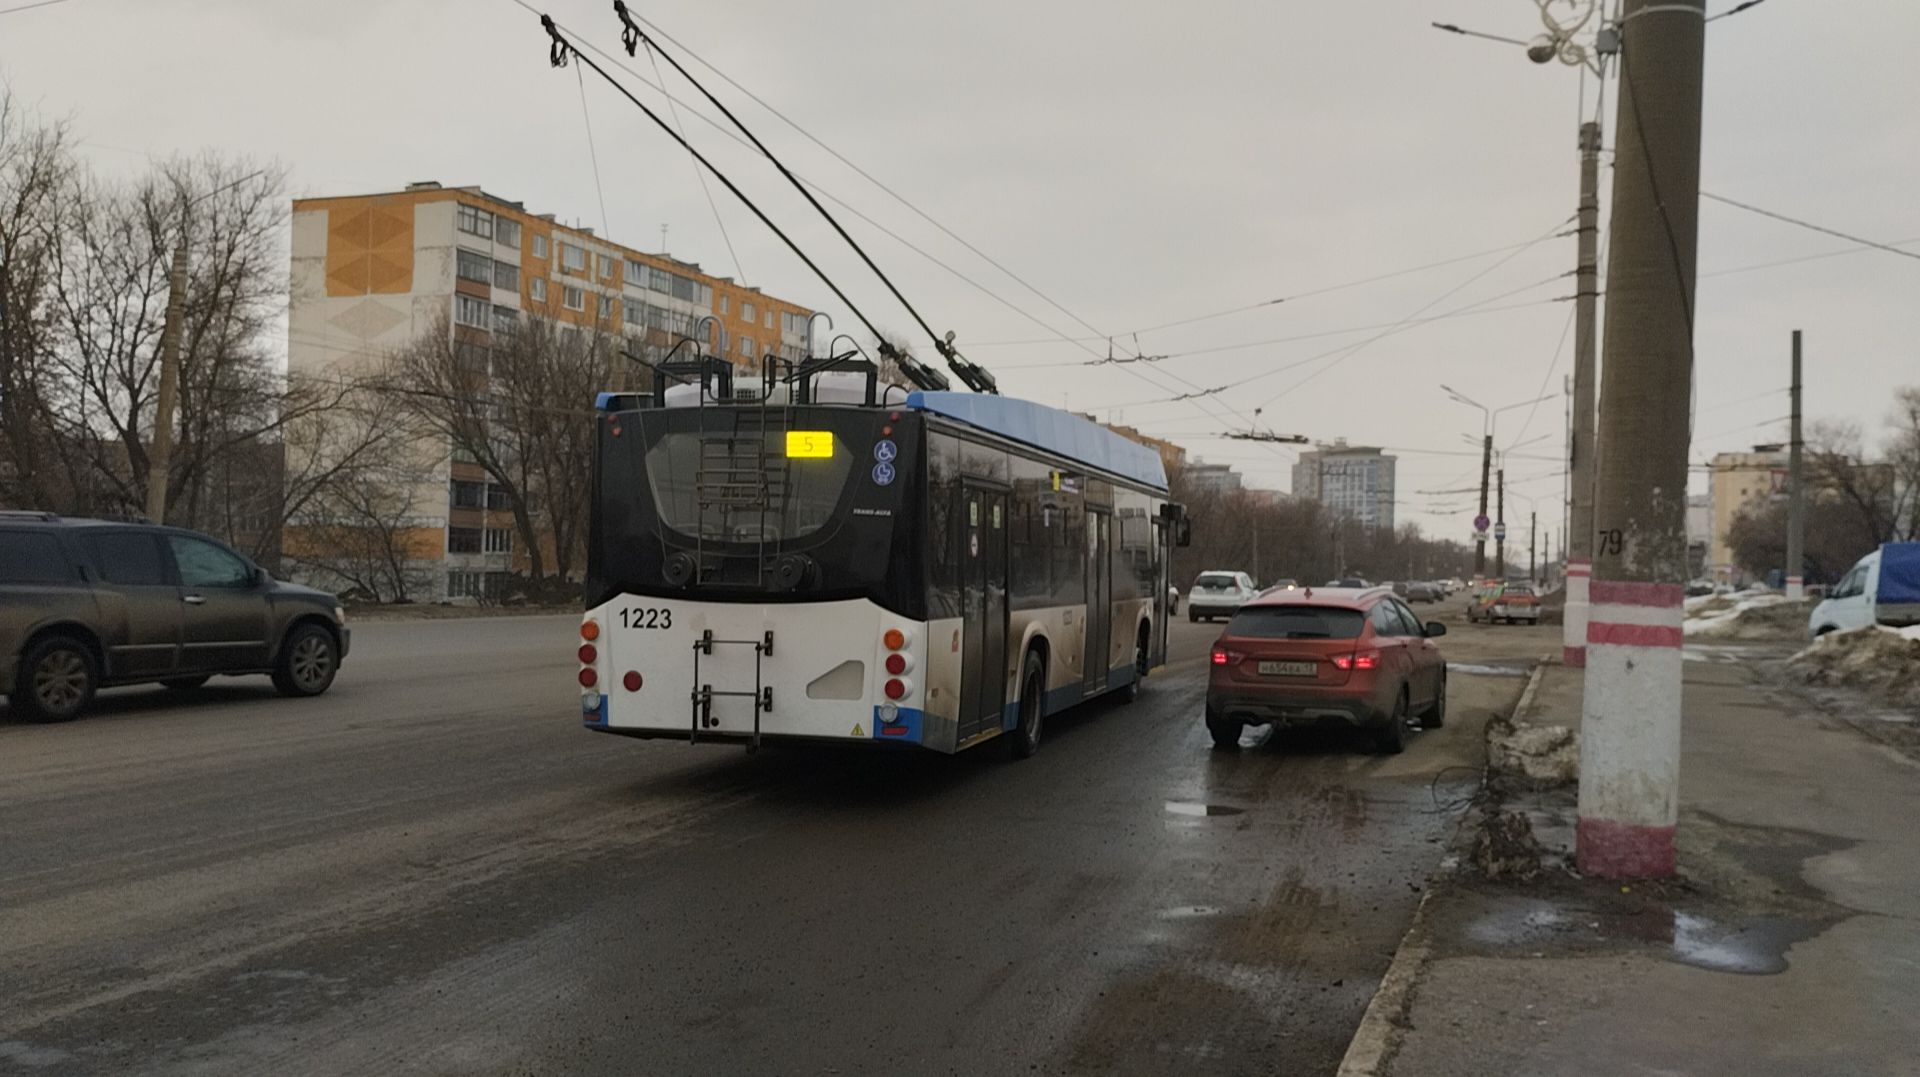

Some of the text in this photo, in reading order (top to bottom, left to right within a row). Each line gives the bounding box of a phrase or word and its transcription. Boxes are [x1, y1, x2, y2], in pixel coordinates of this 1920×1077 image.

[803, 436, 814, 452] 5
[1599, 528, 1622, 557] 79
[619, 607, 672, 630] 1223
